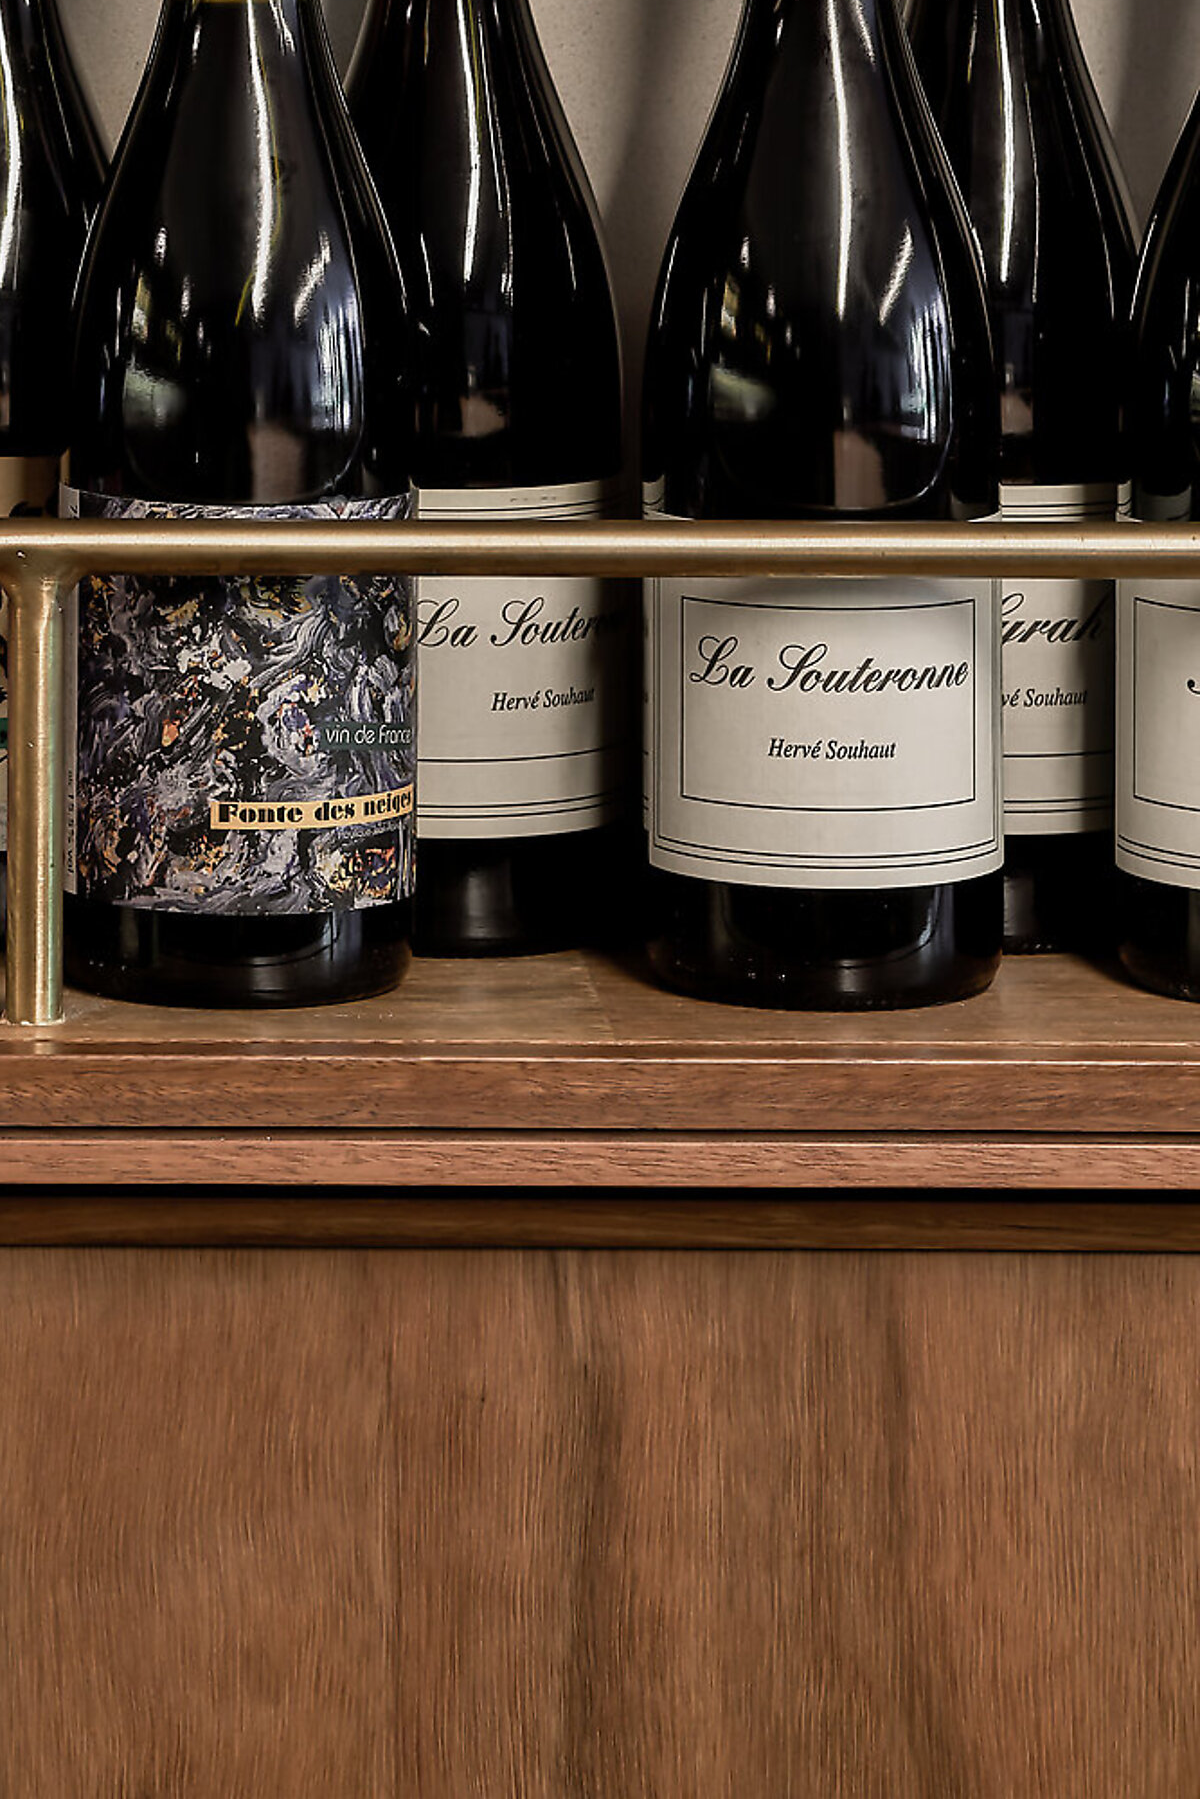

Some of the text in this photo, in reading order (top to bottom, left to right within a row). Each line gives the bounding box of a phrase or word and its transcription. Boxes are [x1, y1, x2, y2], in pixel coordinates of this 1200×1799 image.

[417, 598, 478, 648] La
[690, 636, 969, 693] La Souteronne
[490, 686, 595, 711] Hervé Souhaut
[1023, 687, 1088, 708] Souhaut
[325, 726, 350, 744] vin
[354, 725, 376, 744] de
[767, 738, 897, 760] Hervé Souhaut
[218, 803, 304, 823] Fonte
[314, 801, 355, 821] des
